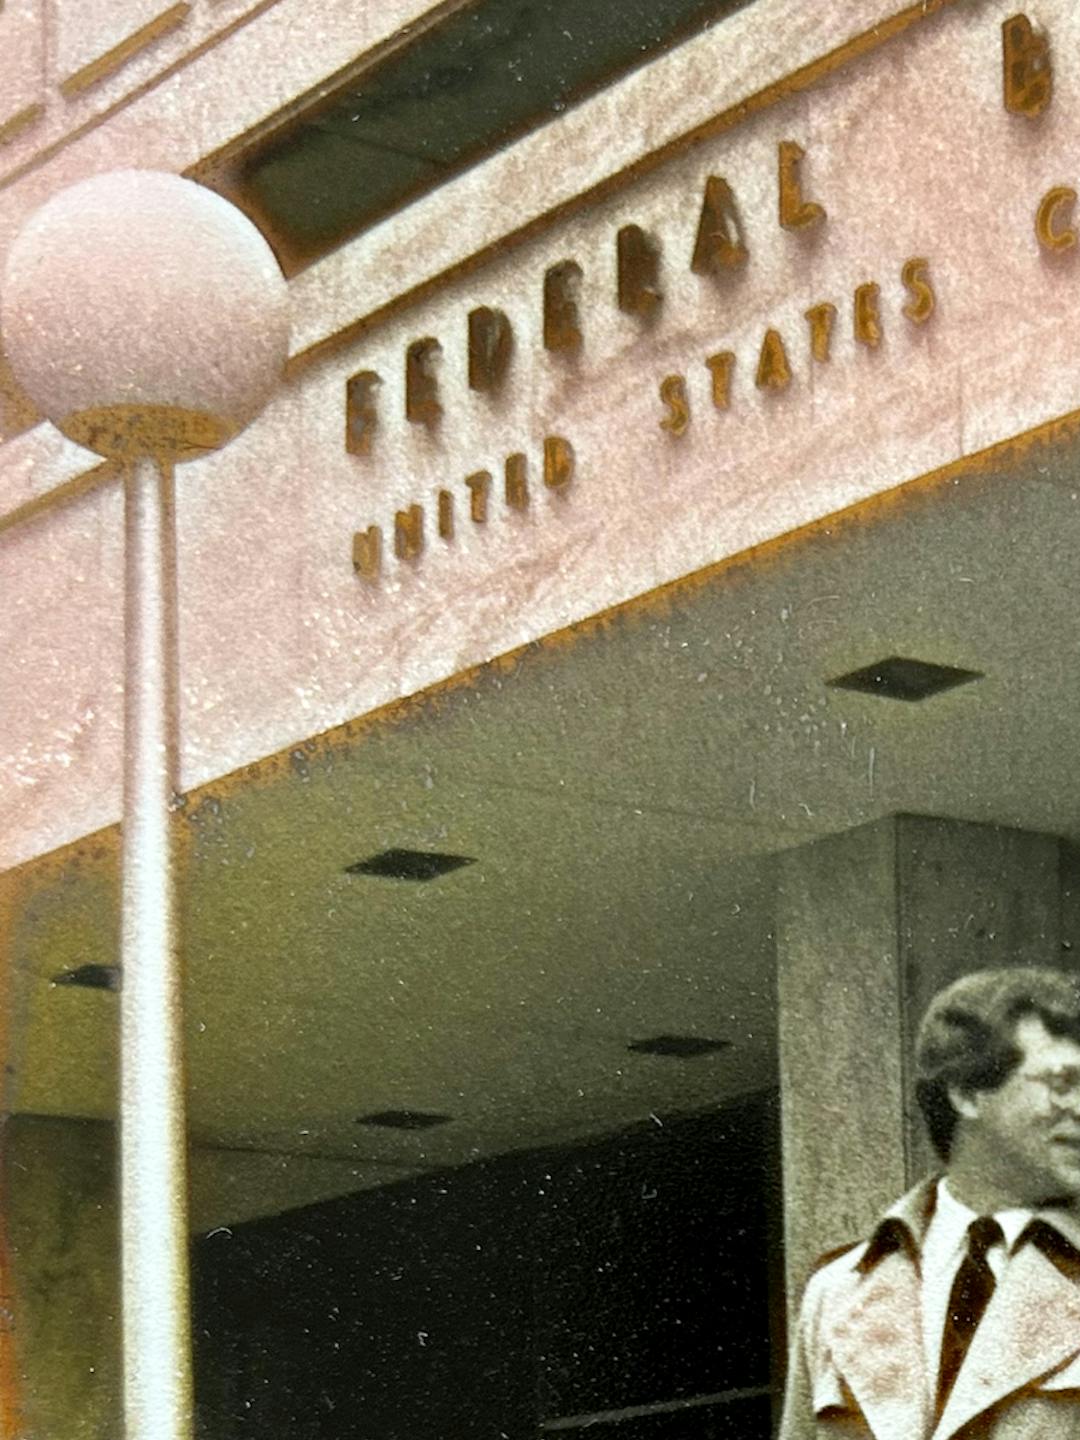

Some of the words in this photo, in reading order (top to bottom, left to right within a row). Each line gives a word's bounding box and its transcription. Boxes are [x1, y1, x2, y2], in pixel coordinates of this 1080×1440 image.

[346, 140, 827, 456] FEDERAL
[353, 434, 575, 579] UNITED
[659, 256, 935, 438] STATES
